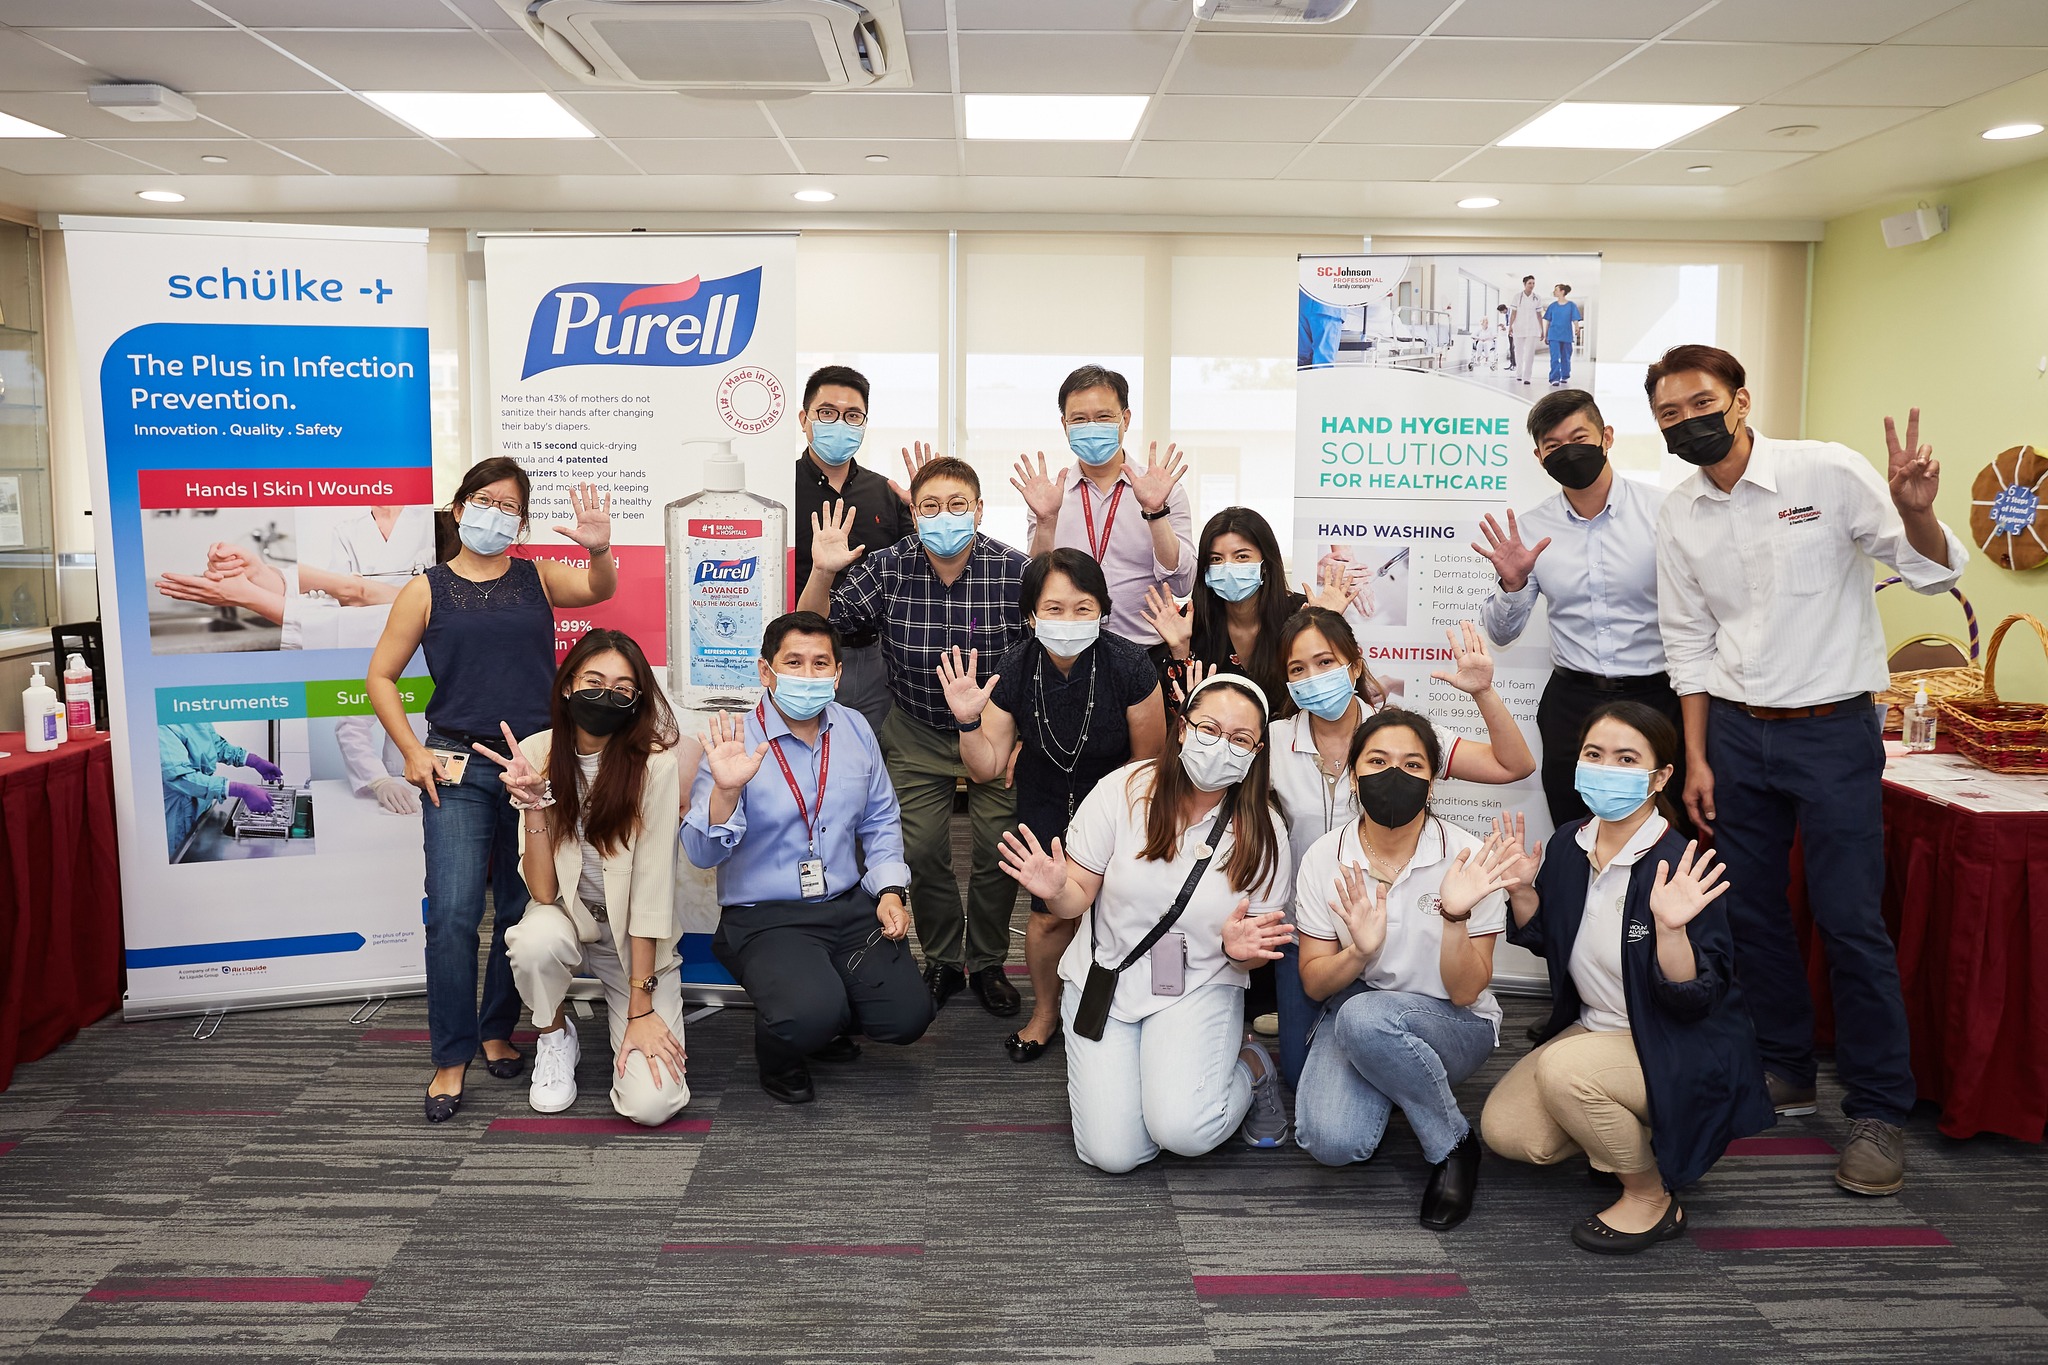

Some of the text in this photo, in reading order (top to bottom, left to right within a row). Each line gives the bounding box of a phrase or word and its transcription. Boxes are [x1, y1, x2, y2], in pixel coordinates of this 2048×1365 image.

[169, 266, 343, 302] schülke
[552, 292, 740, 355] Purell
[127, 354, 414, 379] The Plus in Infection
[726, 371, 781, 400] Made in USA
[131, 388, 296, 410] Prevention.
[501, 394, 650, 403] More than 43% of mothers do not
[501, 408, 654, 418] sanitize their hands after changing
[720, 398, 779, 431] #1 in Hospitals
[134, 423, 343, 438] Innovation Quality Safety
[502, 422, 590, 432] their baby's diapers.
[1322, 416, 1510, 435] HAND HYGIENE
[502, 442, 522, 450] With
[545, 442, 577, 450] second
[580, 442, 637, 451] quick-drying
[538, 455, 554, 463] and
[566, 456, 608, 465] patented
[1321, 442, 1508, 467] SOLUTIONS
[572, 470, 594, 479] keep
[596, 471, 616, 479] your
[1320, 473, 1507, 490] FOR HEALTHCARE
[186, 480, 393, 497] Hands Skin Wounds
[537, 483, 553, 491] and
[614, 484, 649, 493] keeping
[2008, 485, 2016, 495] 6
[2021, 487, 2030, 498] 7
[530, 497, 551, 505] ands
[620, 497, 652, 507] healthy
[1996, 493, 2004, 504] 2
[551, 511, 574, 521] baby
[622, 511, 644, 519] been
[1990, 509, 1999, 520] 3
[702, 524, 714, 535] #1
[1318, 524, 1455, 539] HAND WASHING
[2012, 524, 2020, 535] 5
[1434, 554, 1472, 563] Lotions
[701, 562, 751, 580] Purell
[1433, 570, 1494, 580] Dermatolog
[1433, 586, 1453, 594] Mild
[1456, 586, 1463, 594] &
[1369, 647, 1454, 660] SANITISIN
[1508, 680, 1535, 690] foam
[173, 691, 415, 713] Instruments Sures
[1428, 692, 1456, 701] 5000
[1428, 708, 1448, 717] Kills
[1430, 797, 1502, 808] onditions skin
[373, 938, 407, 946] performance
